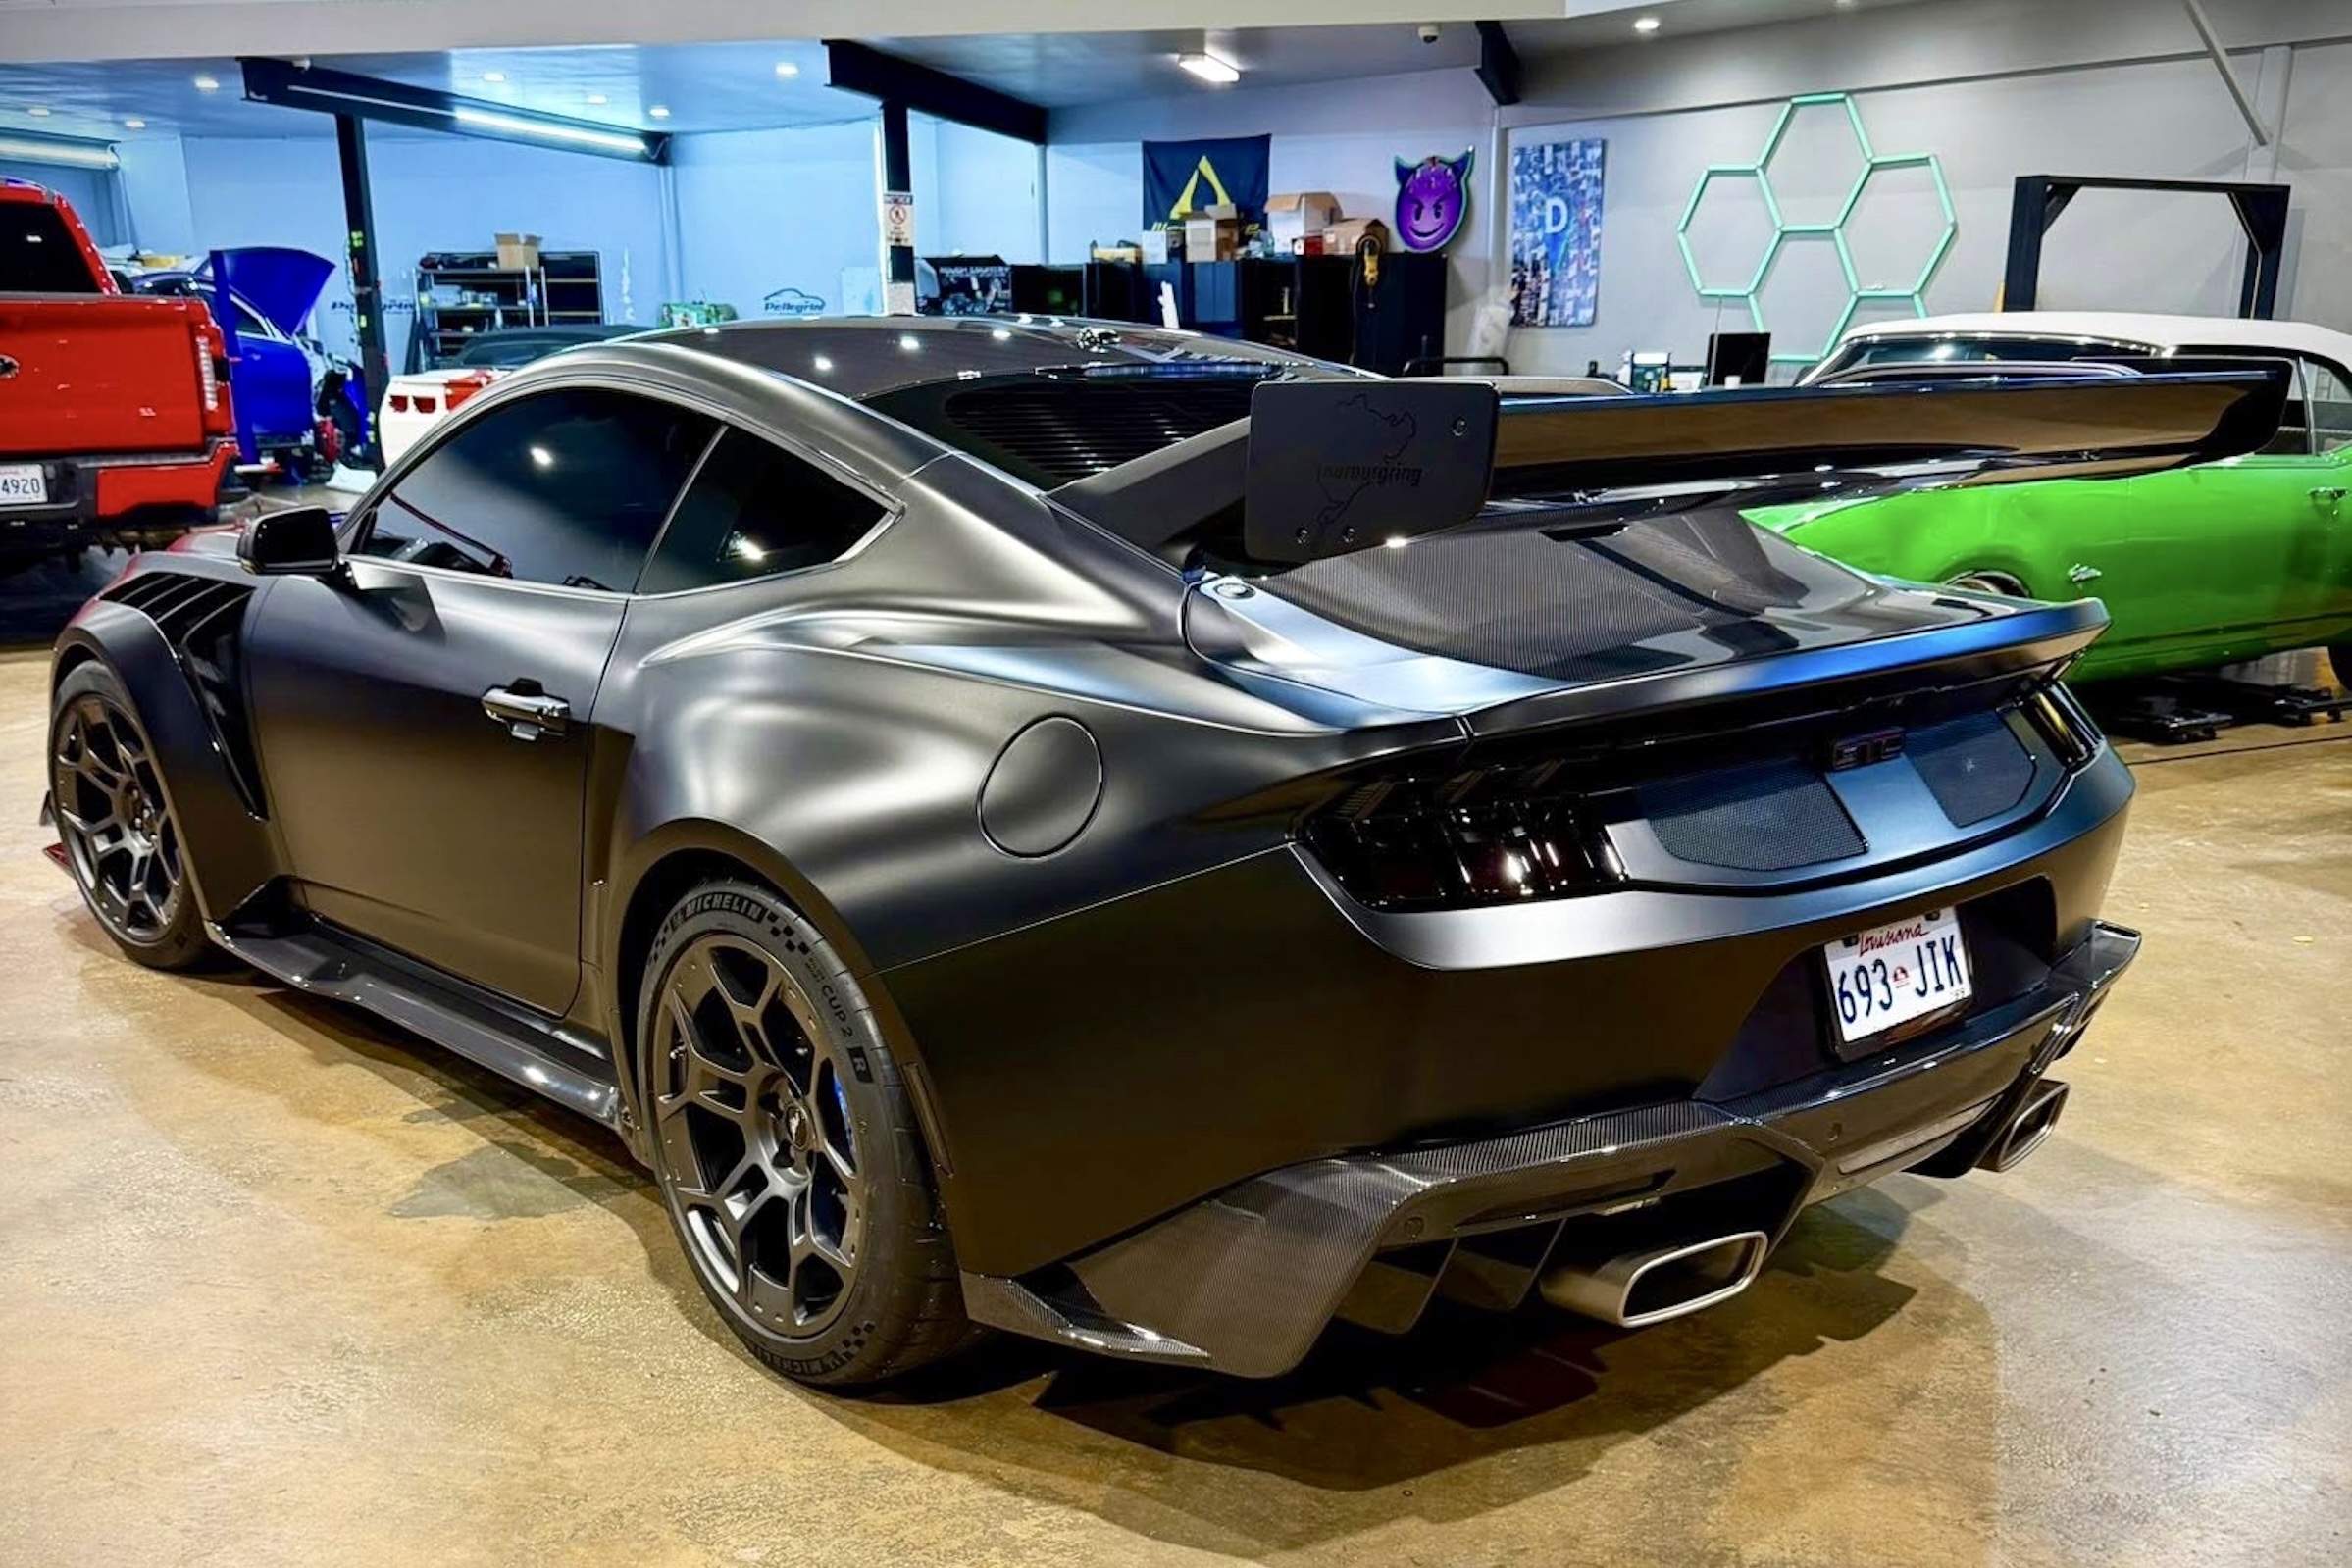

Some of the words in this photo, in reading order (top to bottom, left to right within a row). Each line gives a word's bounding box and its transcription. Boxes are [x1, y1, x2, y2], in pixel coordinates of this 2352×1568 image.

[685, 893, 763, 921] MICHELIN
[1859, 922, 1931, 957] Louisiana
[1837, 958, 1894, 1024] 693
[1915, 934, 1964, 998] JIK
[821, 984, 848, 1022] CUP
[842, 1027, 854, 1037] 2
